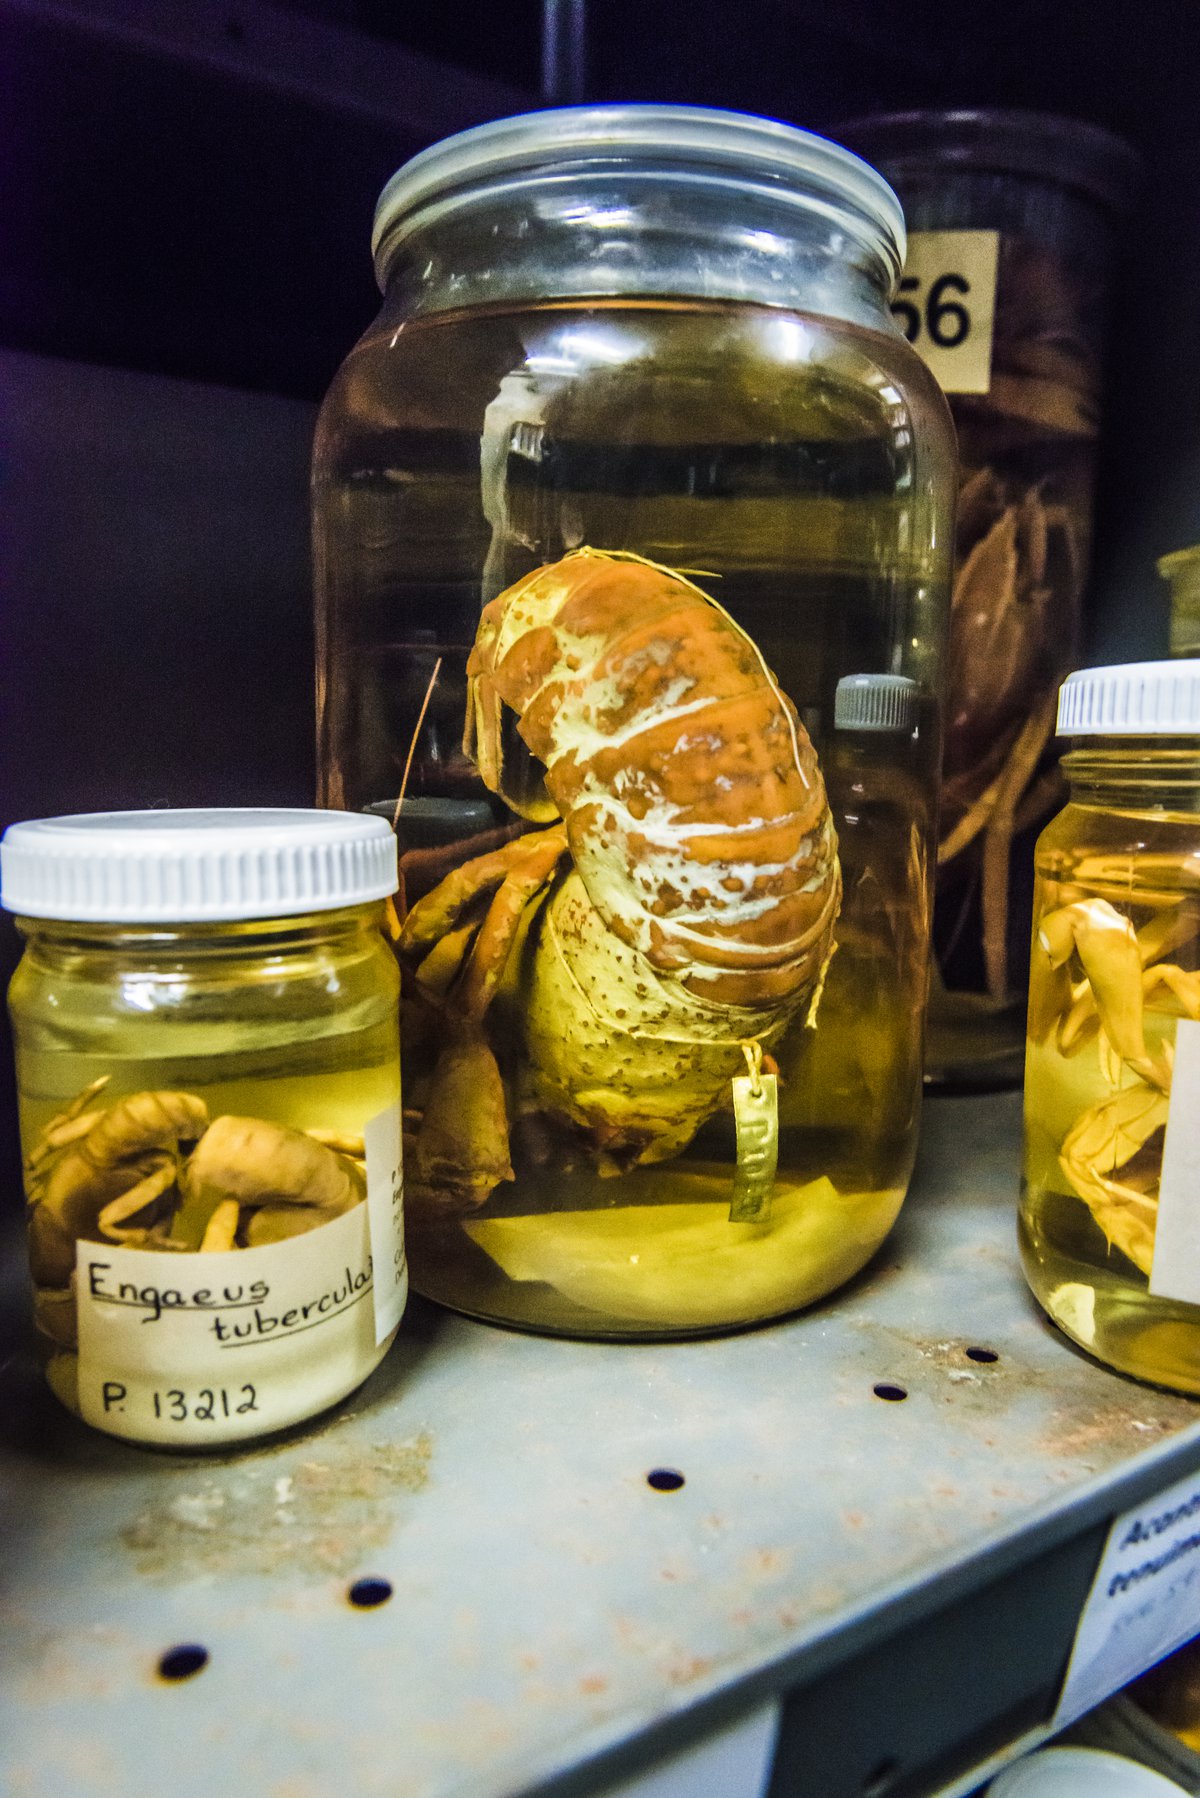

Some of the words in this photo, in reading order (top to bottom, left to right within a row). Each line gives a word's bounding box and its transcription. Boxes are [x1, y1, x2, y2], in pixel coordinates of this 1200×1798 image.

[88, 1261, 270, 1324] Engaeus
[101, 1381, 127, 1413] P.
[153, 1384, 260, 1421] 13212
